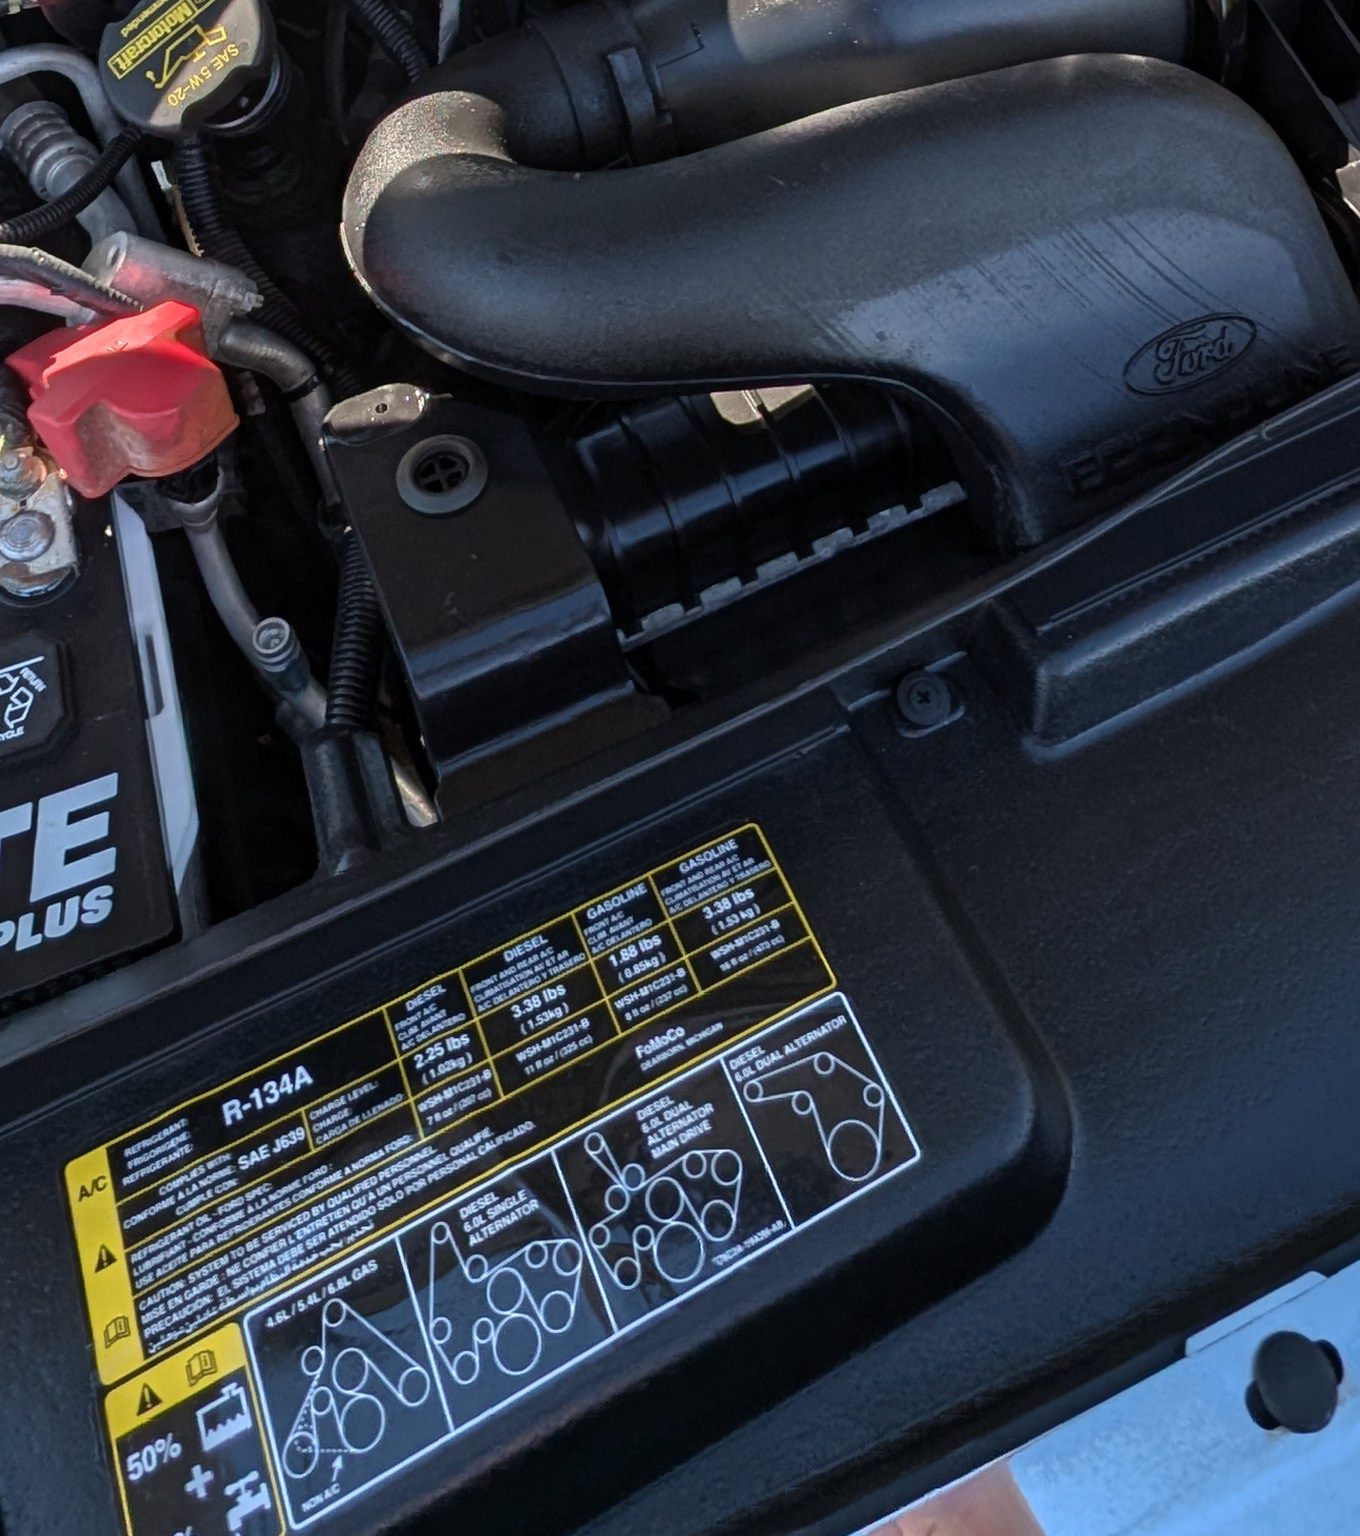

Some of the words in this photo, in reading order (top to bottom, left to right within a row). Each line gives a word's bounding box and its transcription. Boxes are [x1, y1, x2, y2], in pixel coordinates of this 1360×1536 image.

[116, 0, 193, 71] Motorcraft
[211, 43, 240, 71] SAE
[678, 839, 738, 873] GASOLINE
[586, 884, 646, 919] GASOLINE
[701, 897, 732, 919] 3.38
[730, 885, 755, 904] lbs
[502, 933, 548, 961] DIESEL
[608, 944, 639, 967] 1.88
[637, 932, 662, 952] lbs
[710, 919, 780, 959] WSH-M1C231-B
[404, 982, 447, 1011] DIESEL
[509, 994, 542, 1019] 3.38
[542, 981, 567, 1002] lbs
[615, 968, 686, 1009] WSH-M1C231-B
[412, 1042, 445, 1069] 2.25
[444, 1029, 471, 1053] lbs
[516, 1018, 589, 1060] WSH-M1C231-B
[633, 1024, 686, 1058] FoMoCo
[728, 1044, 765, 1069] DIESEL
[733, 1064, 756, 1083] 6.0L
[755, 1049, 784, 1070] DUAL
[783, 1015, 846, 1054] ALTERNATOR
[221, 1064, 313, 1123] R-134A
[417, 1069, 491, 1113] WSH-M1C231-B
[635, 1094, 675, 1121] DIESEL
[639, 1115, 663, 1134] 6.0L
[662, 1098, 694, 1121] DUAL
[646, 1103, 714, 1145] ALTERNATOR
[237, 1144, 270, 1170] SAE
[271, 1126, 305, 1153] J639
[650, 1137, 679, 1159] MAIN
[678, 1118, 712, 1143] DRIVE
[76, 1174, 108, 1201] A/C
[189, 1238, 214, 1257] PARA
[292, 1171, 342, 1201] CONFORME
[351, 1148, 384, 1170] NORMA
[458, 1190, 499, 1218] DIESEL
[131, 1223, 193, 1261] REFRIGERANT
[217, 1196, 243, 1215] FORD
[188, 1255, 228, 1283] SYSTEM
[230, 1245, 245, 1260] TO
[245, 1237, 260, 1252] BE
[262, 1212, 309, 1242] SERVICED
[311, 1203, 325, 1217] BY
[327, 1176, 377, 1207] QUALIFIED
[232, 1259, 275, 1288] SISTEMA
[277, 1244, 304, 1264] DEBE
[305, 1232, 326, 1249] SER
[327, 1205, 375, 1236] ATENDIDO
[377, 1189, 404, 1210] SOLO
[404, 1177, 426, 1195] POR
[427, 1151, 477, 1182] PERSONAL
[462, 1213, 485, 1233] 6.0L
[486, 1190, 529, 1219] SINGLE
[467, 1201, 539, 1246] ALTERNATOR
[141, 1304, 165, 1324] MISE
[167, 1294, 183, 1309] EN
[184, 1275, 219, 1300] GARDE
[226, 1263, 241, 1278] NE
[243, 1239, 286, 1267] CONFIER
[376, 1182, 391, 1196] UN
[393, 1152, 448, 1186] PERSONNEL
[263, 1307, 289, 1330] 4.6L
[297, 1289, 321, 1311] 5.4L
[351, 1258, 378, 1281] GAS
[127, 1431, 183, 1483] 50%
[300, 1492, 324, 1513] NON
